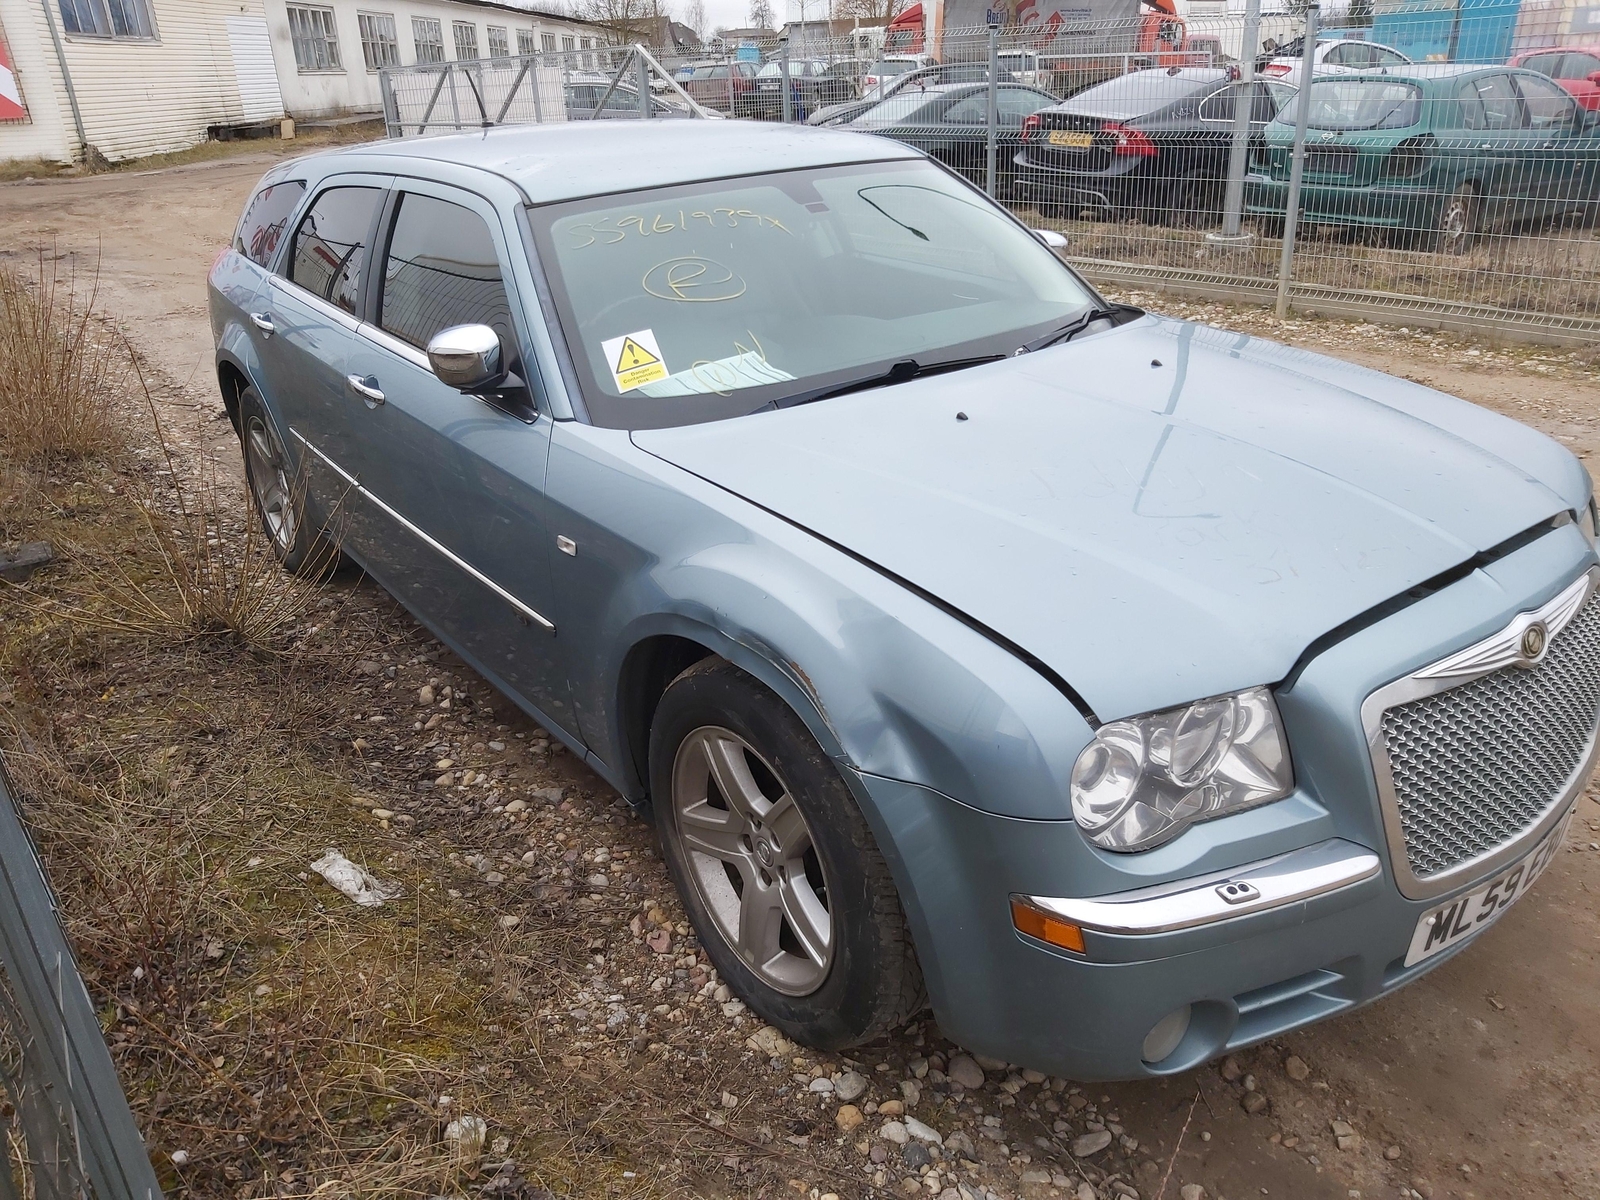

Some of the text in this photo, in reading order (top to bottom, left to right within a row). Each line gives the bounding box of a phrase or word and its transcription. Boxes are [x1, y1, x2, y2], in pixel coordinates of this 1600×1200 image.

[623, 369, 661, 384] Contamination
[630, 368, 650, 377] Danger
[1424, 864, 1526, 952] ML59
